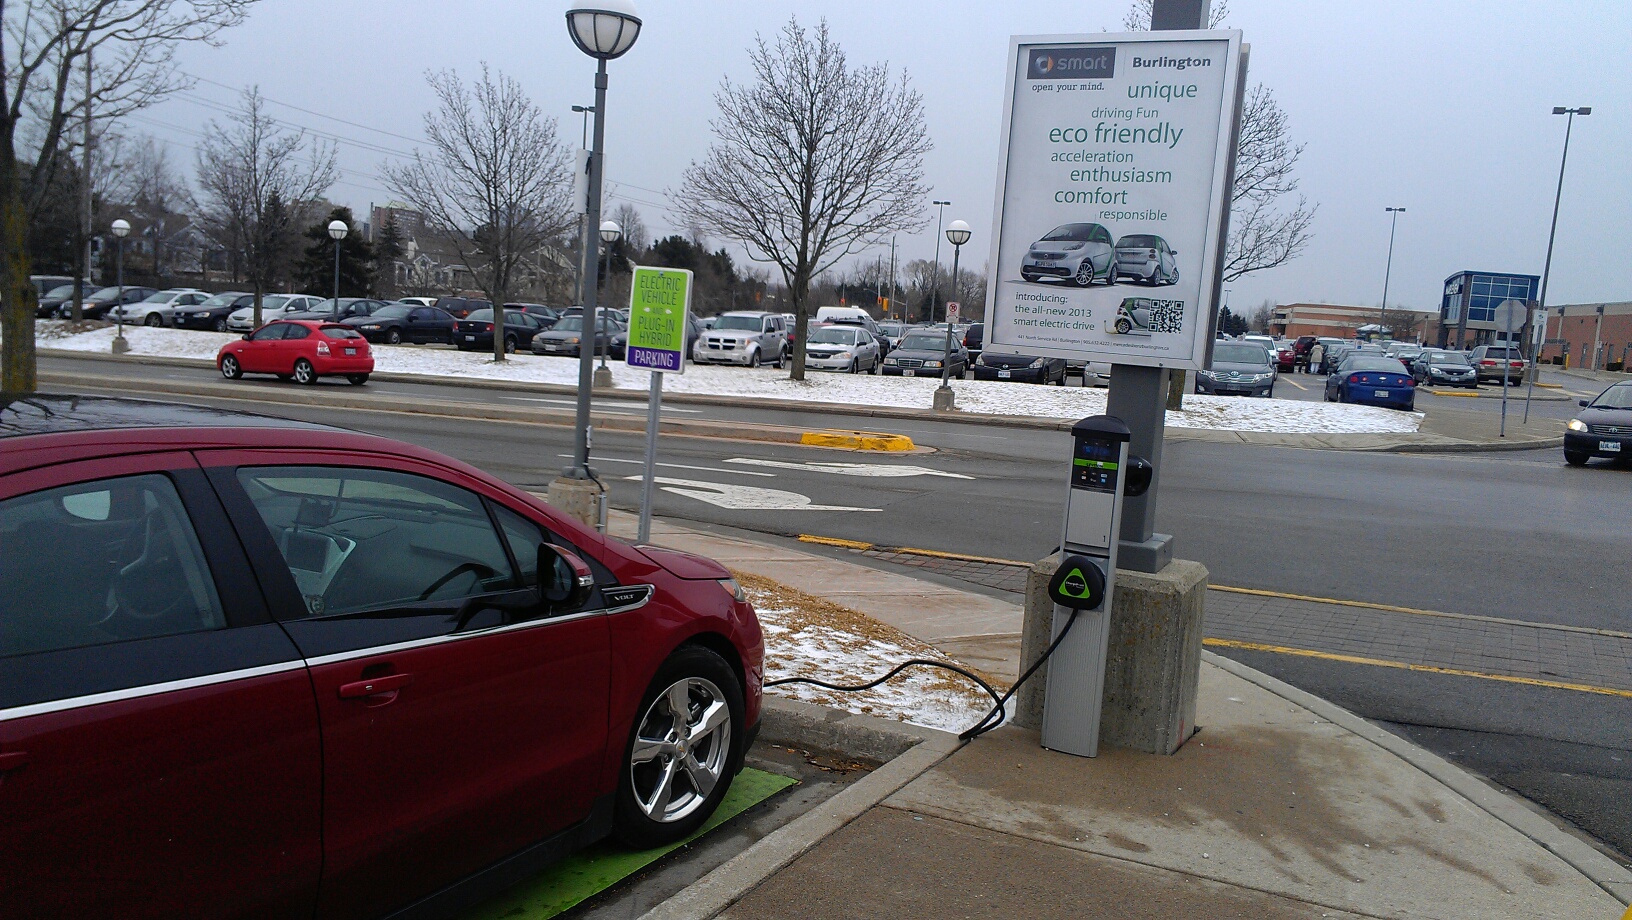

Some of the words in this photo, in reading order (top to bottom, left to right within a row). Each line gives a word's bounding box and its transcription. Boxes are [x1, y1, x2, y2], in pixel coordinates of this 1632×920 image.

[1057, 55, 1107, 71] smart
[1132, 56, 1211, 70] Burlington
[1032, 83, 1053, 92] open
[1056, 83, 1077, 92] your
[1080, 82, 1105, 91] mind.
[1127, 81, 1198, 103] unique
[1091, 107, 1133, 121] driving
[1136, 107, 1159, 118] Fun
[1049, 127, 1088, 143] eco
[1095, 122, 1184, 149] friendly
[1050, 150, 1133, 163] acceleration
[1070, 166, 1172, 183] enthusiasm
[1054, 187, 1128, 205] comfort
[1099, 209, 1168, 222] responsible
[640, 275, 680, 291] ELECTRIC
[641, 290, 677, 306] VEHICLE
[1015, 292, 1068, 304] introducing:
[1015, 305, 1030, 314] the
[1032, 306, 1066, 316] all-new
[1068, 308, 1092, 317] 2013
[639, 315, 675, 333] PLUG-IN
[1013, 318, 1037, 326] smart
[1039, 319, 1070, 329] electric
[1072, 321, 1095, 331] drive
[639, 331, 672, 346] HYBRID
[635, 350, 673, 367] PARKING
